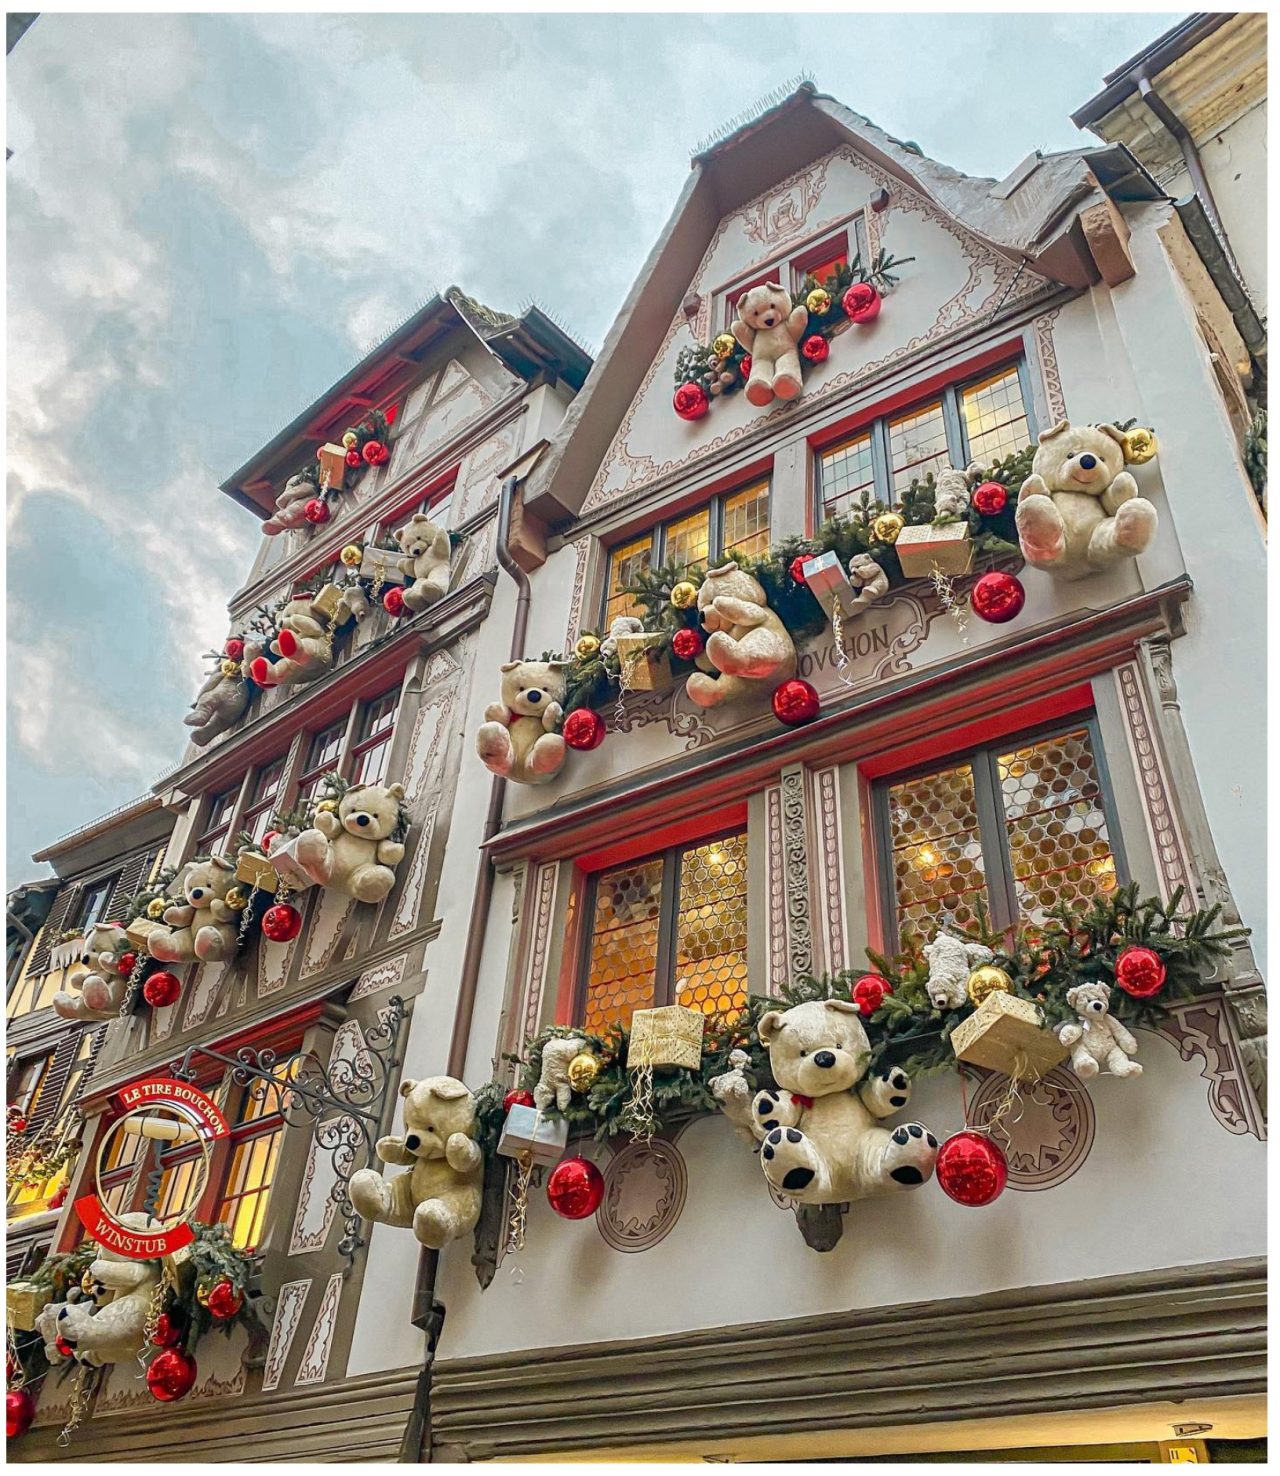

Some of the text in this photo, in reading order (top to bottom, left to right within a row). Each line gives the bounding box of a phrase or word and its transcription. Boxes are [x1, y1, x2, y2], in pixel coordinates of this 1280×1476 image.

[796, 624, 890, 678] OVCHON
[123, 1084, 225, 1136] LE TIRE BOUCHON
[95, 1218, 167, 1253] WINSTUB
